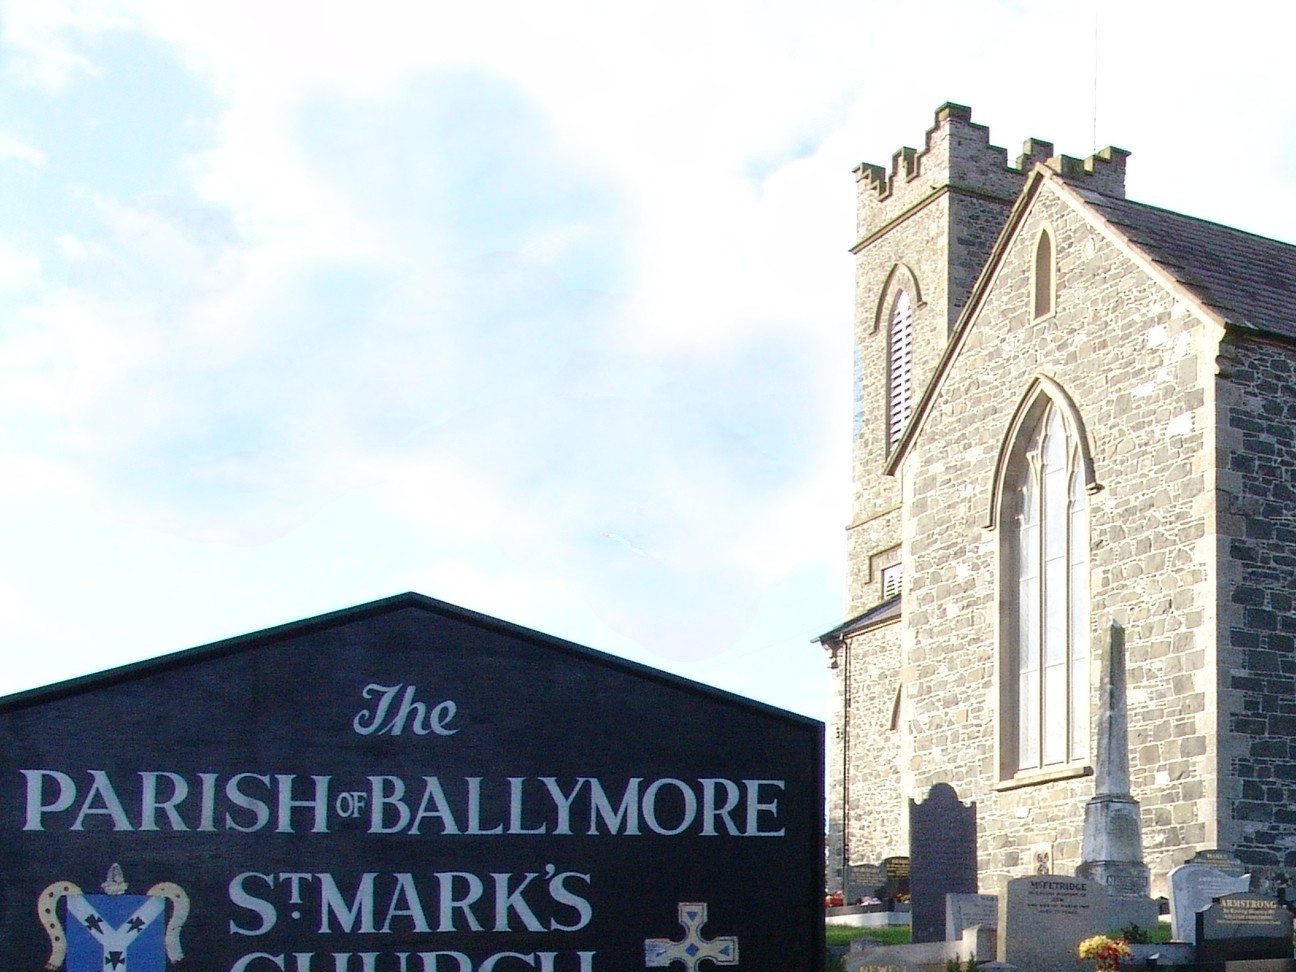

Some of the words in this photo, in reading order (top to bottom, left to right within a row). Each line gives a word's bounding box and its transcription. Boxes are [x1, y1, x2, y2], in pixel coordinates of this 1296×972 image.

[354, 683, 458, 736] The
[20, 769, 329, 832] PARISH
[336, 791, 366, 818] OF
[367, 776, 786, 837] BALLYMORE
[314, 863, 593, 934] MARK'S
[1222, 899, 1277, 908] ARMSTRONG
